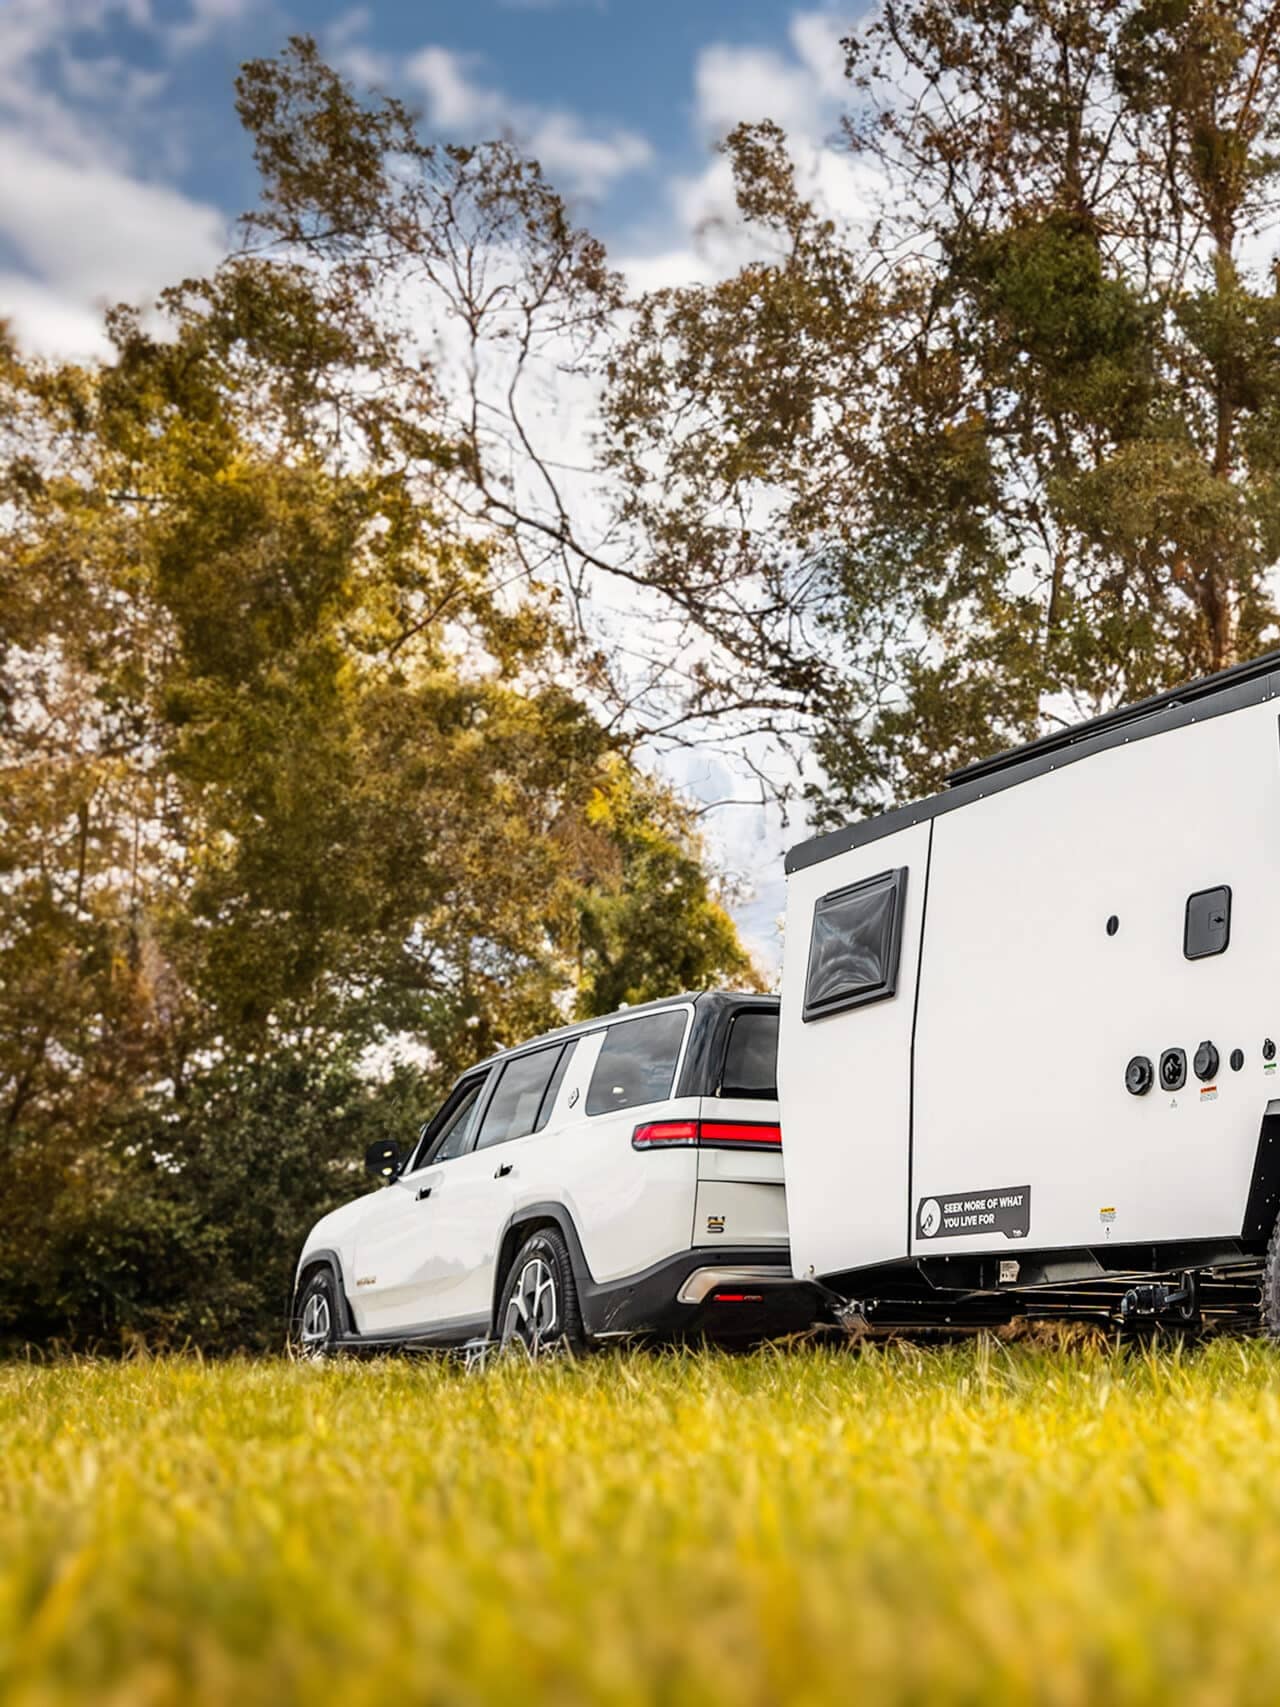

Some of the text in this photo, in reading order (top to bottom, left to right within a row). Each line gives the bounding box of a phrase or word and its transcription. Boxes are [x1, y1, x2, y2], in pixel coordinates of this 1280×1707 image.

[943, 1195, 1023, 1214] SEEK MORE OF WHAT
[943, 1213, 995, 1228] YOU LIVE FOR
